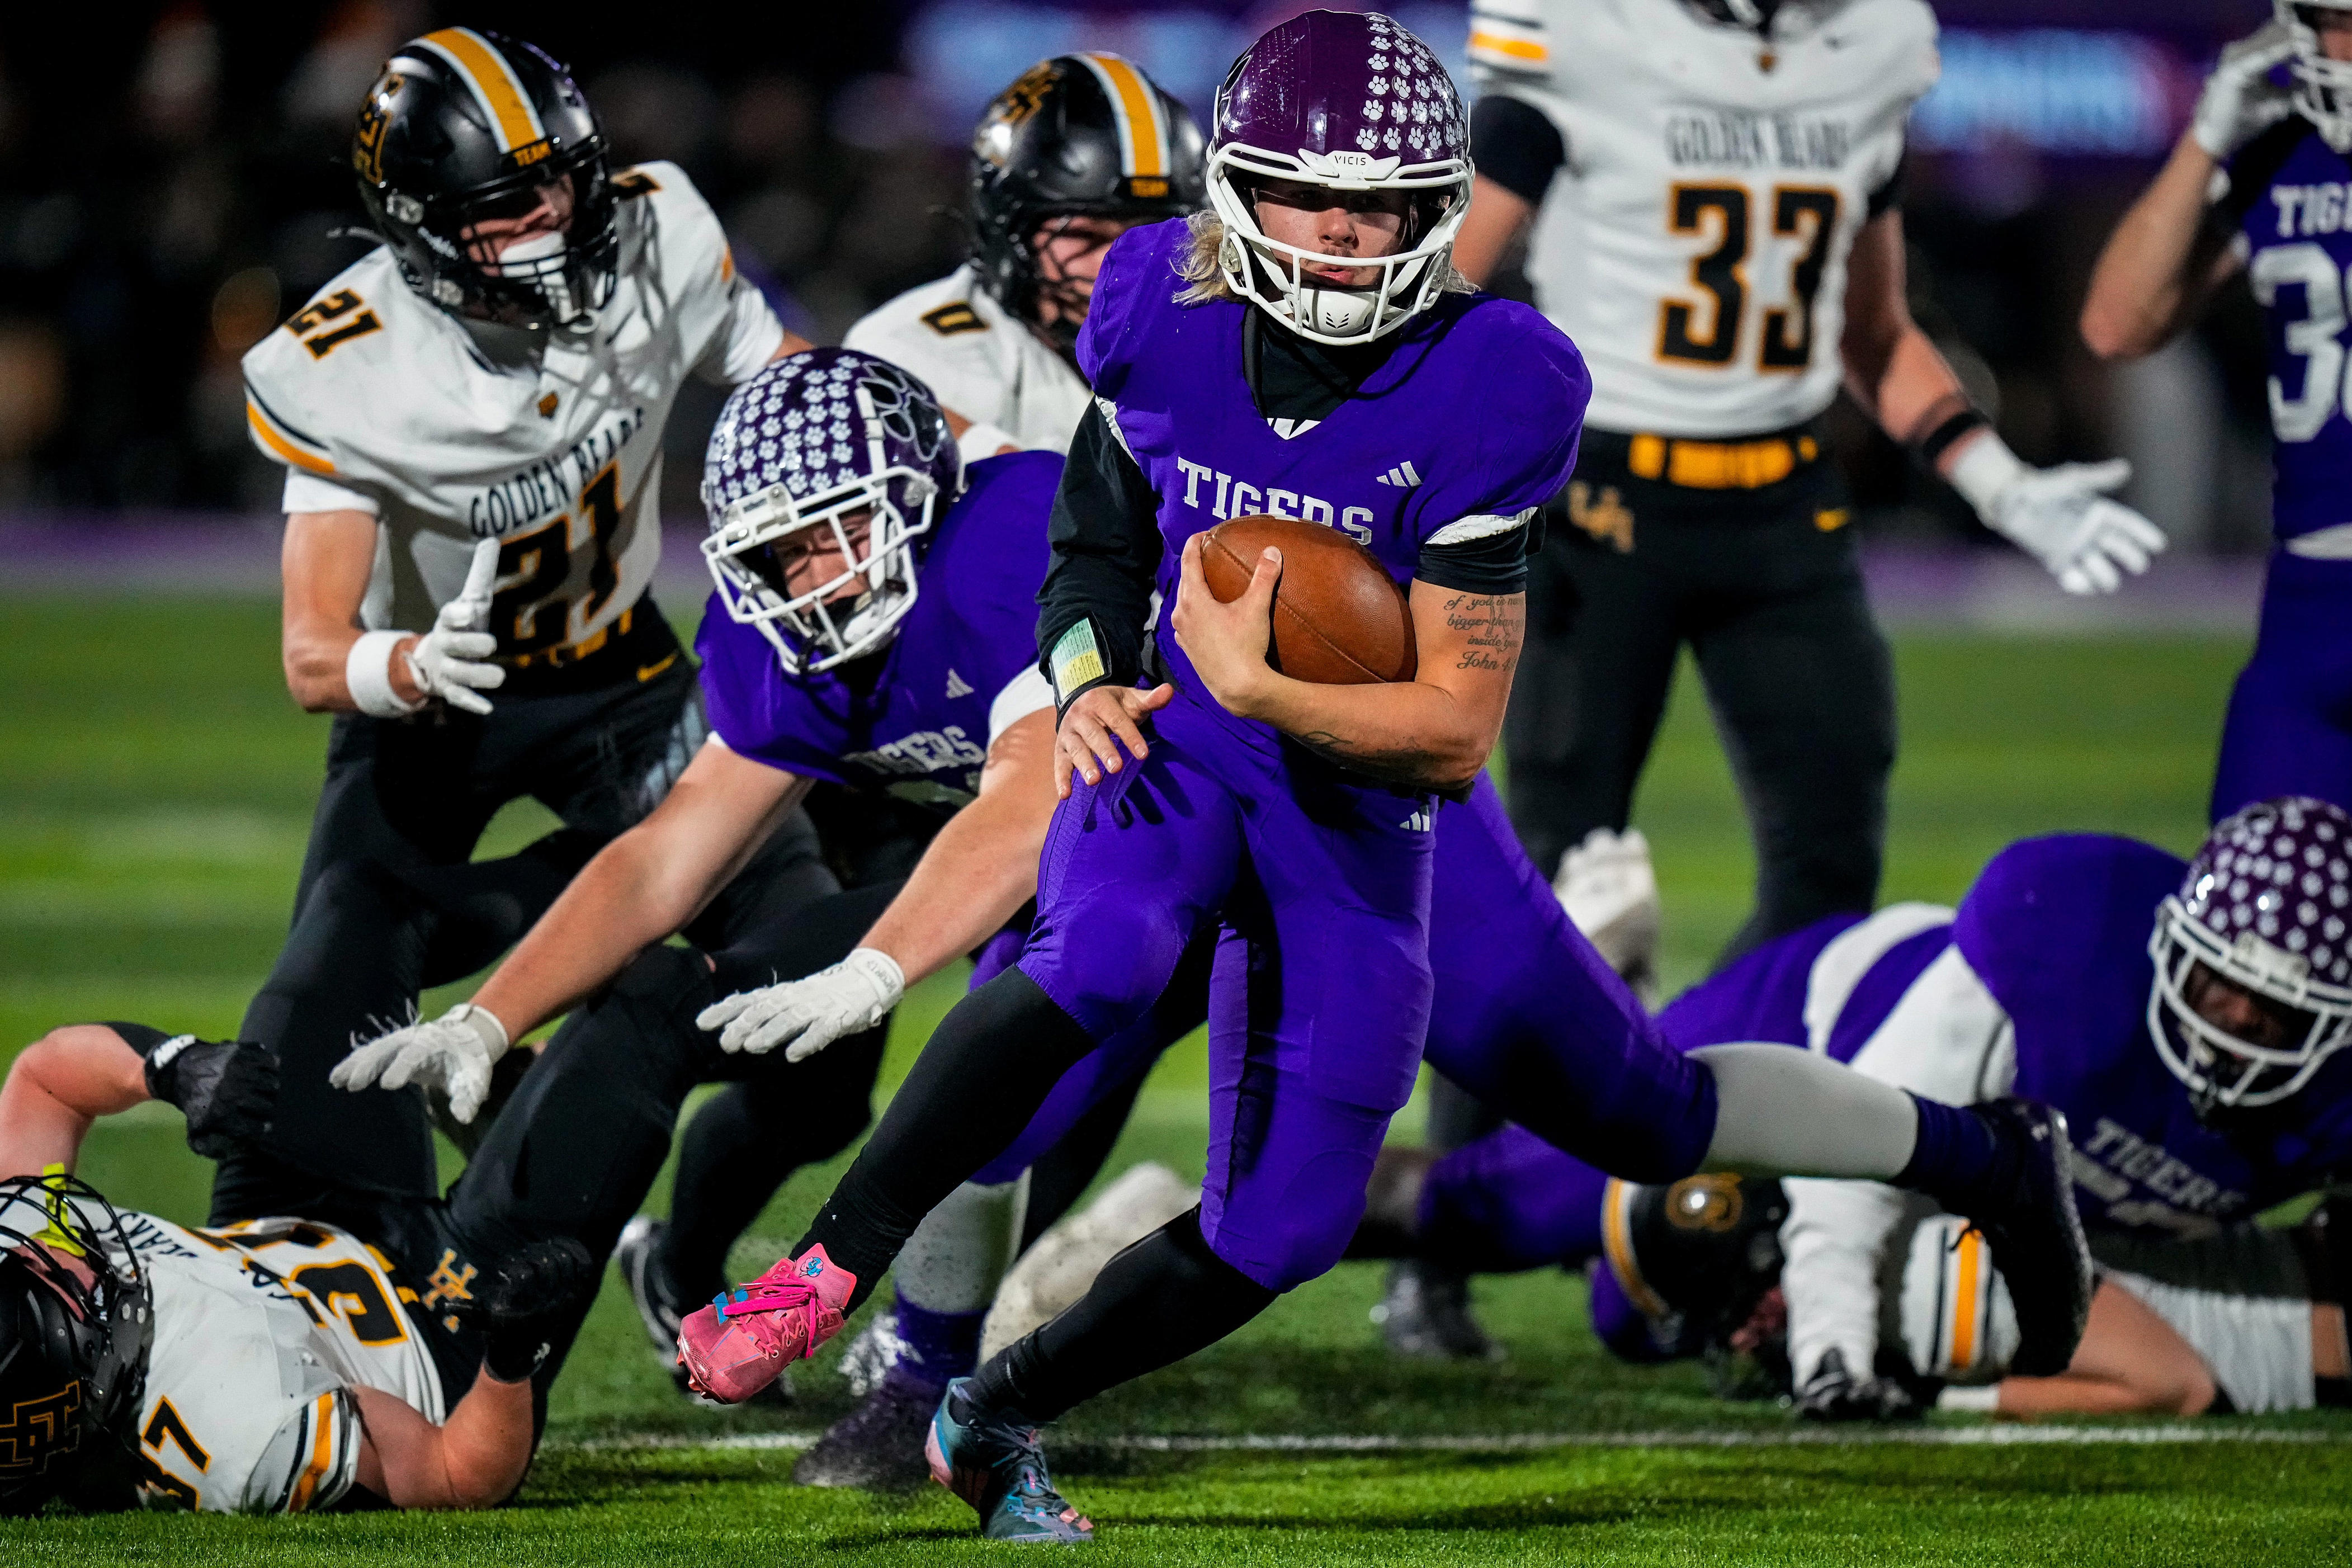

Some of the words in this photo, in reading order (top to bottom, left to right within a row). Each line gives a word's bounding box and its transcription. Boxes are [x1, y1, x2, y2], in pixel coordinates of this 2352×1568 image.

[1334, 155, 1366, 166] VICIS
[1654, 179, 1840, 374] 33
[282, 288, 382, 360] 21
[920, 301, 989, 336] 0
[2250, 240, 2352, 443] 3
[469, 455, 572, 537] GOLDEN
[488, 460, 624, 653] 21
[1444, 594, 1466, 611] of
[1447, 613, 1489, 630] bigger
[1456, 651, 1498, 669] John
